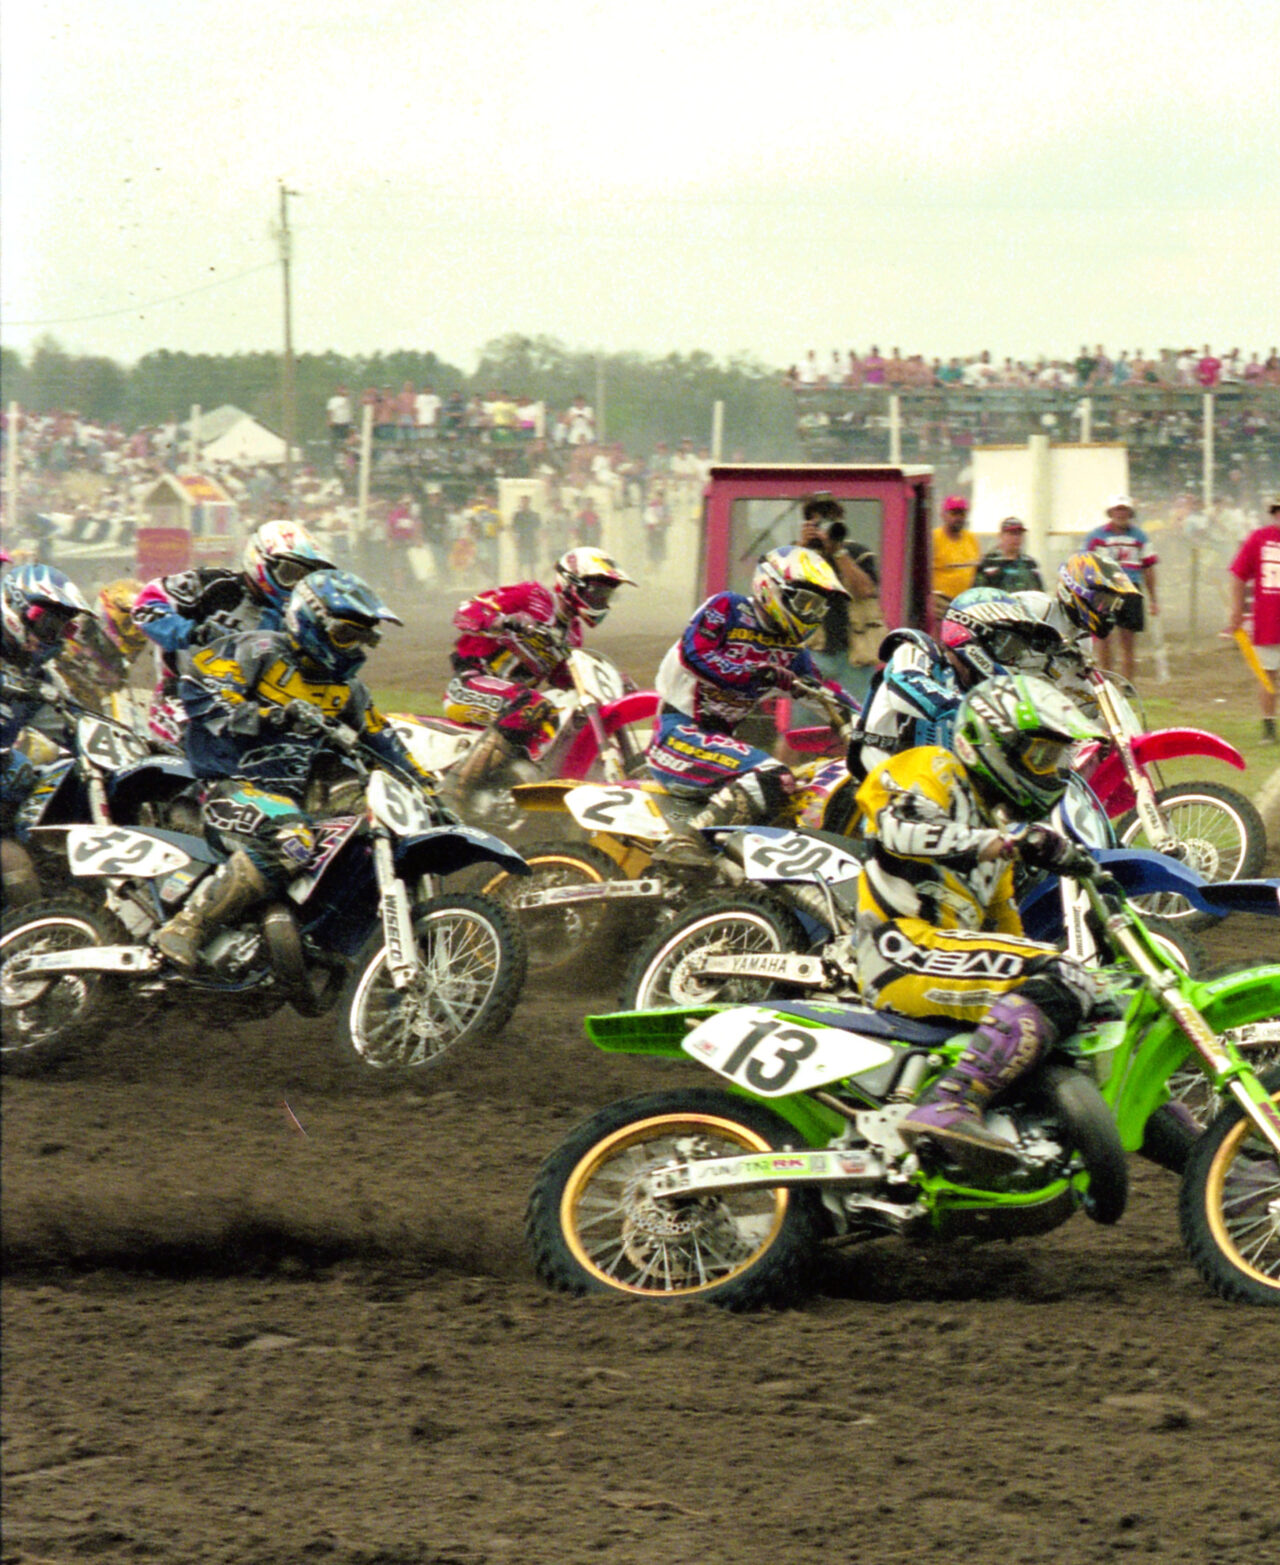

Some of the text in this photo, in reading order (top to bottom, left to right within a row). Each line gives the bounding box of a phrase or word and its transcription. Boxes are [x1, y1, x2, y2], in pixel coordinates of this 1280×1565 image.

[946, 608, 993, 637] SCOTT
[593, 664, 617, 701] 6
[581, 788, 633, 826] 2
[74, 831, 154, 873] 52
[749, 838, 834, 878] 20
[384, 893, 404, 961] WISECO
[732, 956, 788, 973] YAMAHA
[721, 1020, 818, 1092] 13
